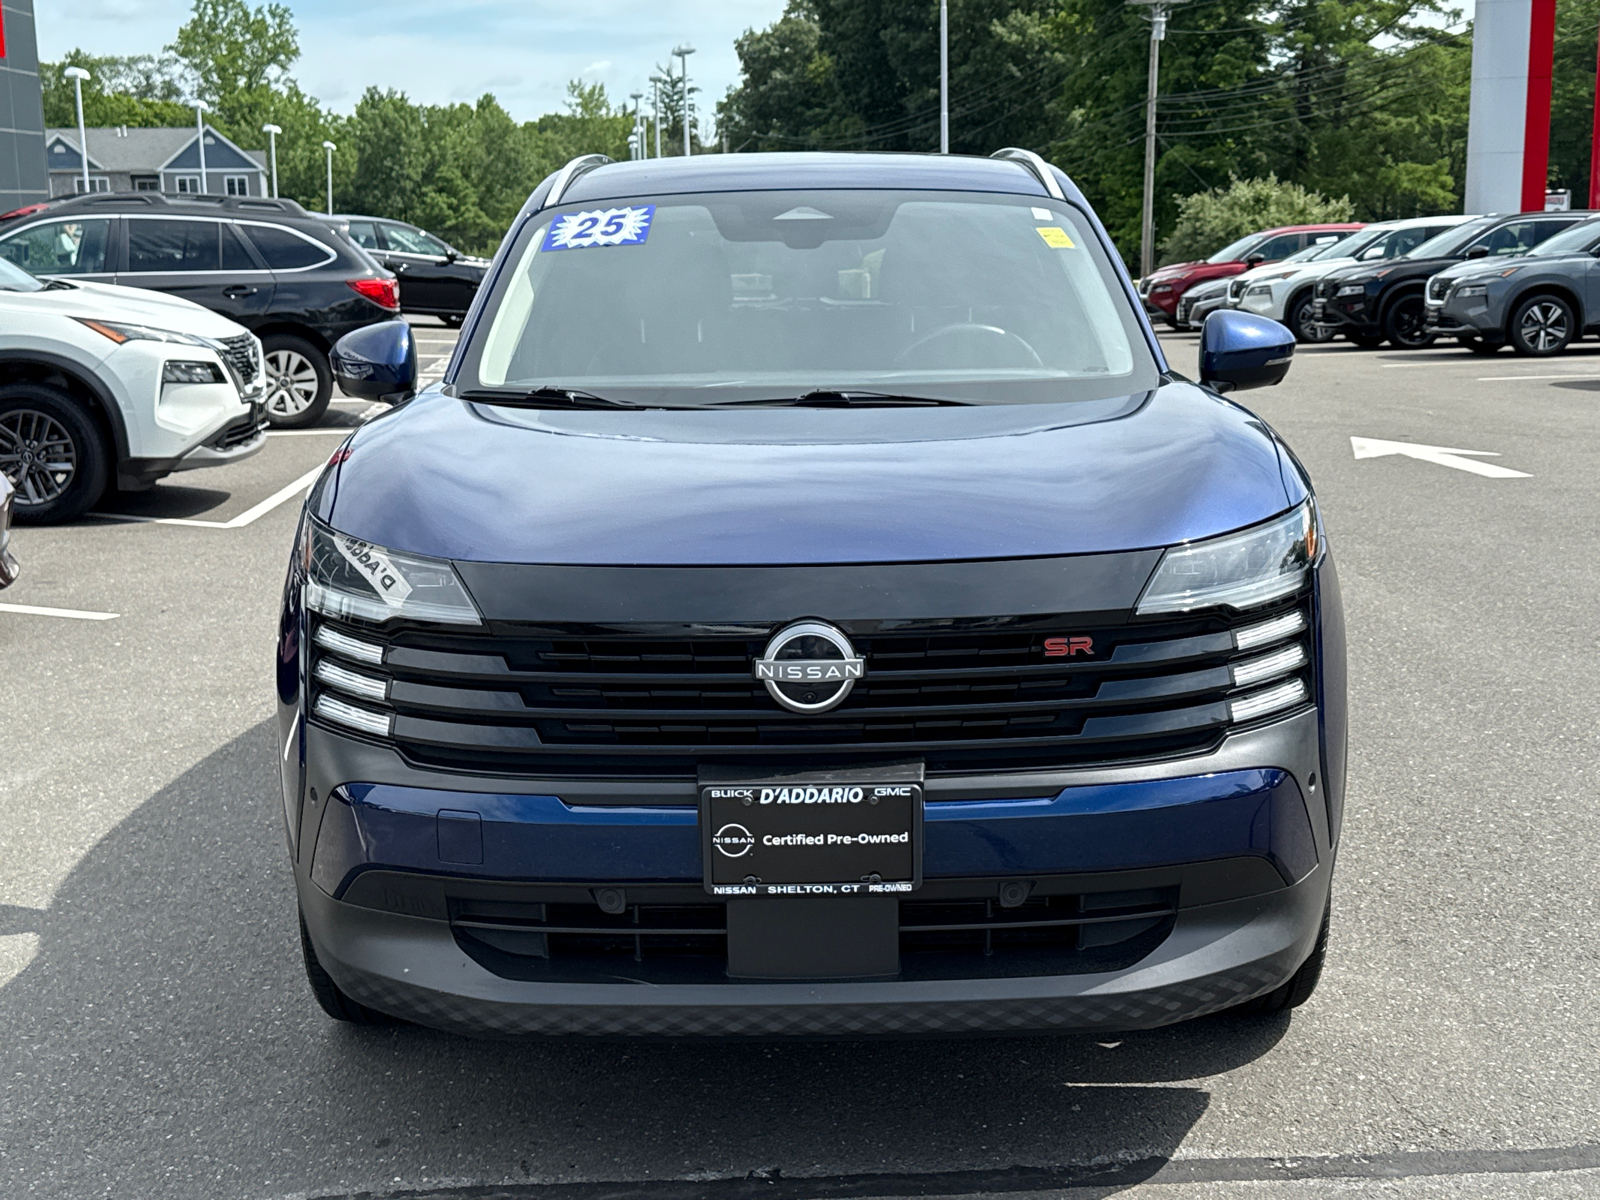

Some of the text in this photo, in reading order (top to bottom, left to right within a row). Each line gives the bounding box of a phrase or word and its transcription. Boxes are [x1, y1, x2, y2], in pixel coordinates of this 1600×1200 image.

[570, 213, 628, 240] 25
[1044, 636, 1095, 656] SR
[758, 663, 861, 679] NISSAN
[711, 787, 911, 804] BUICK D'ADDARIO GMC
[713, 836, 755, 844] NISSAN
[762, 832, 909, 846] Certified Pre-Owned
[714, 883, 912, 895] NISSAN SHELTON, CT PRE-OWNED
